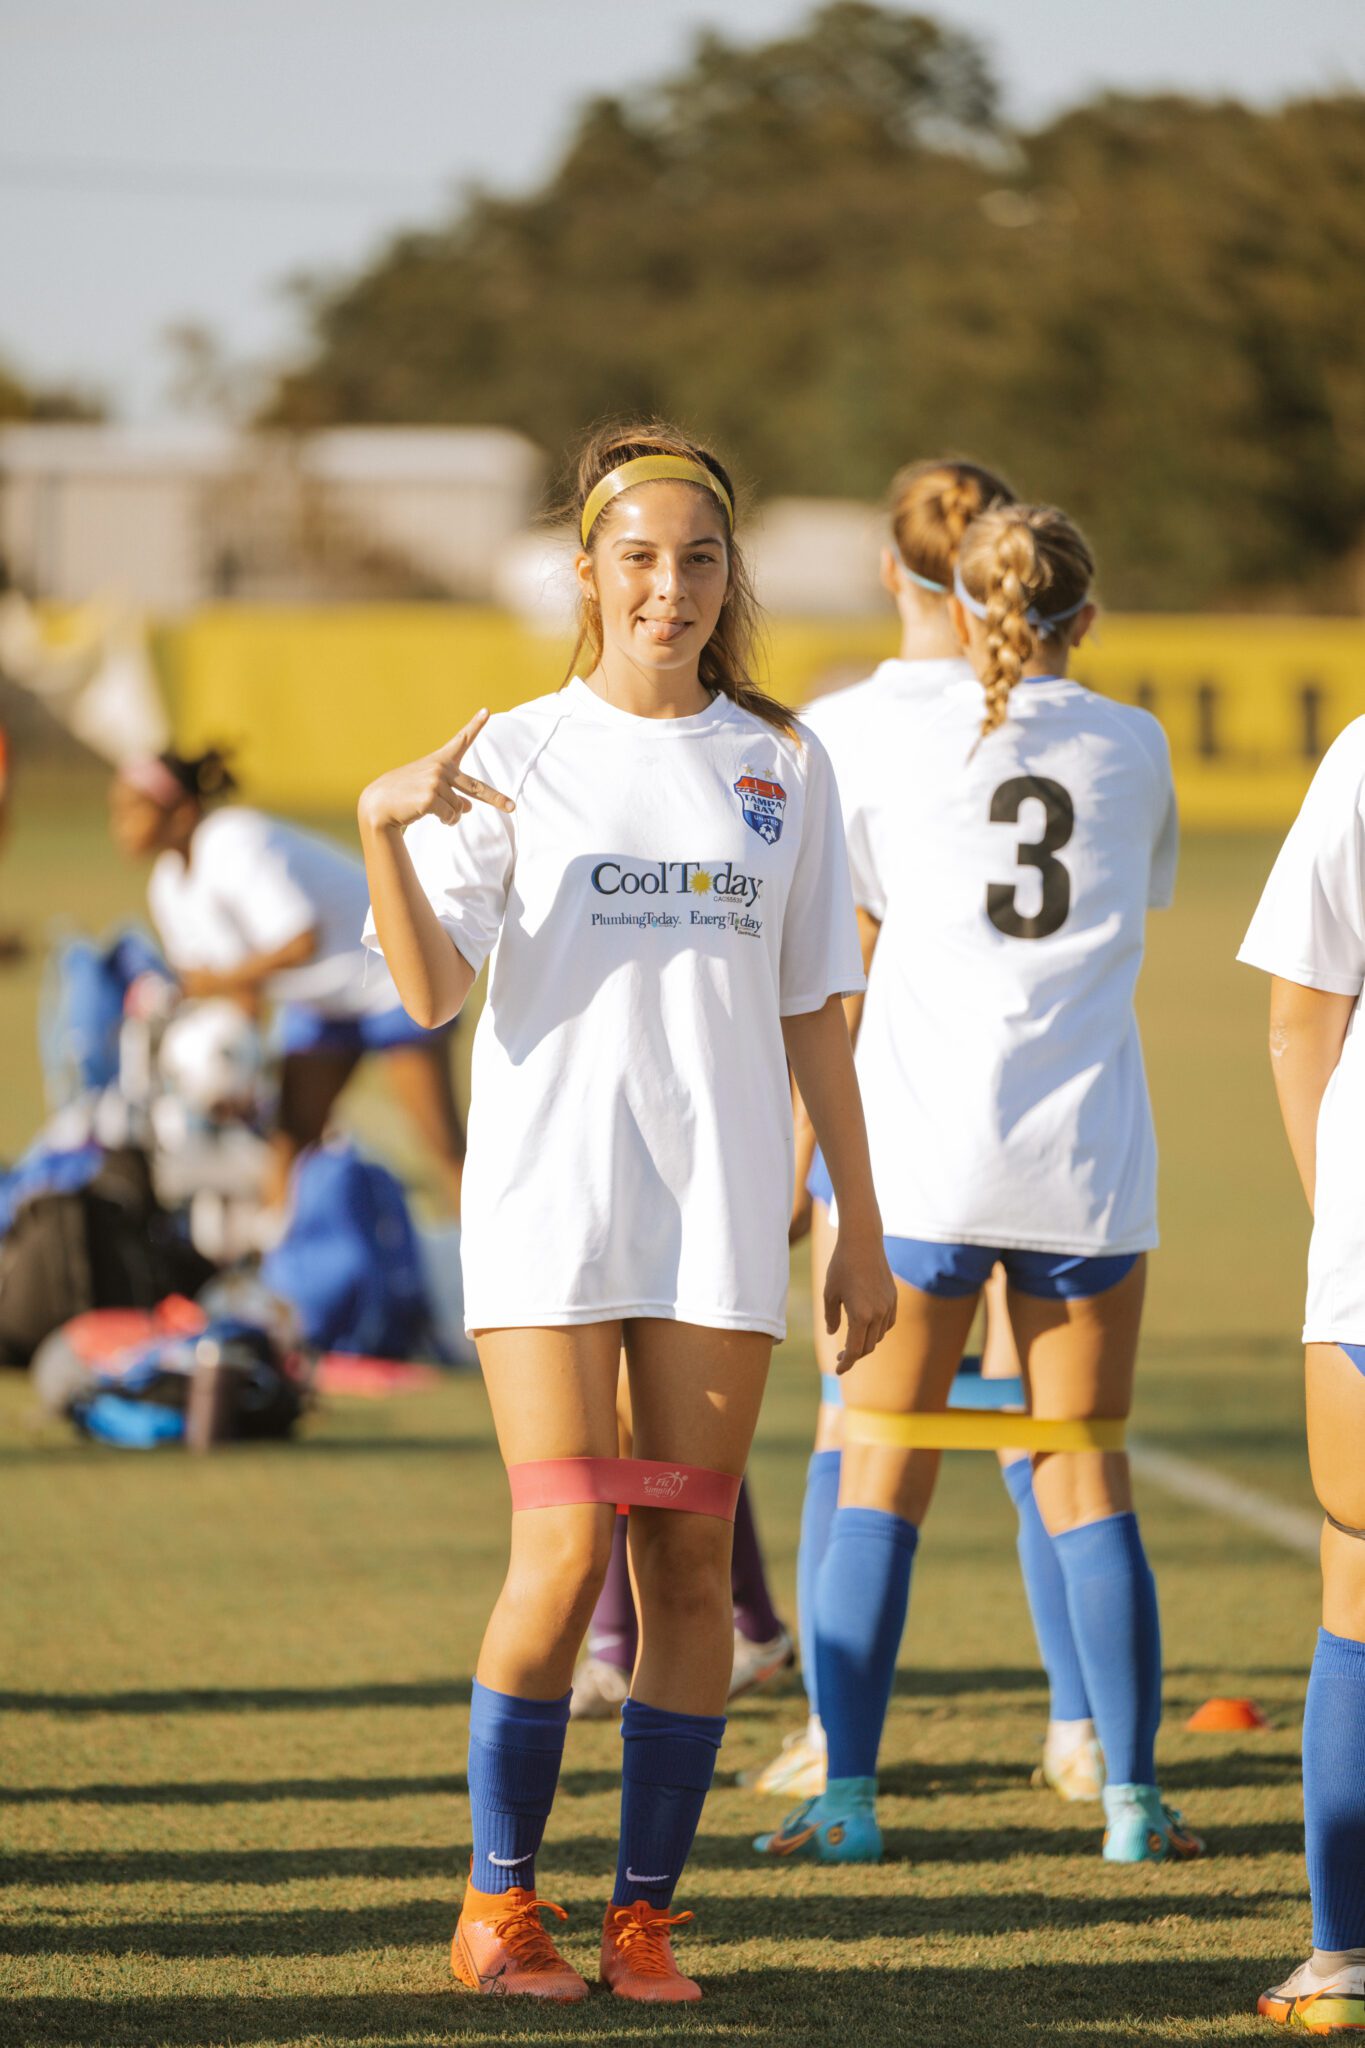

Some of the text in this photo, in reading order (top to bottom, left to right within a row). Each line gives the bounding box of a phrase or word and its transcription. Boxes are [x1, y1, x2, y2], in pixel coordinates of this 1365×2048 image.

[742, 794, 782, 809] TAMPA
[753, 804, 776, 815] BAY
[986, 775, 1075, 940] 3
